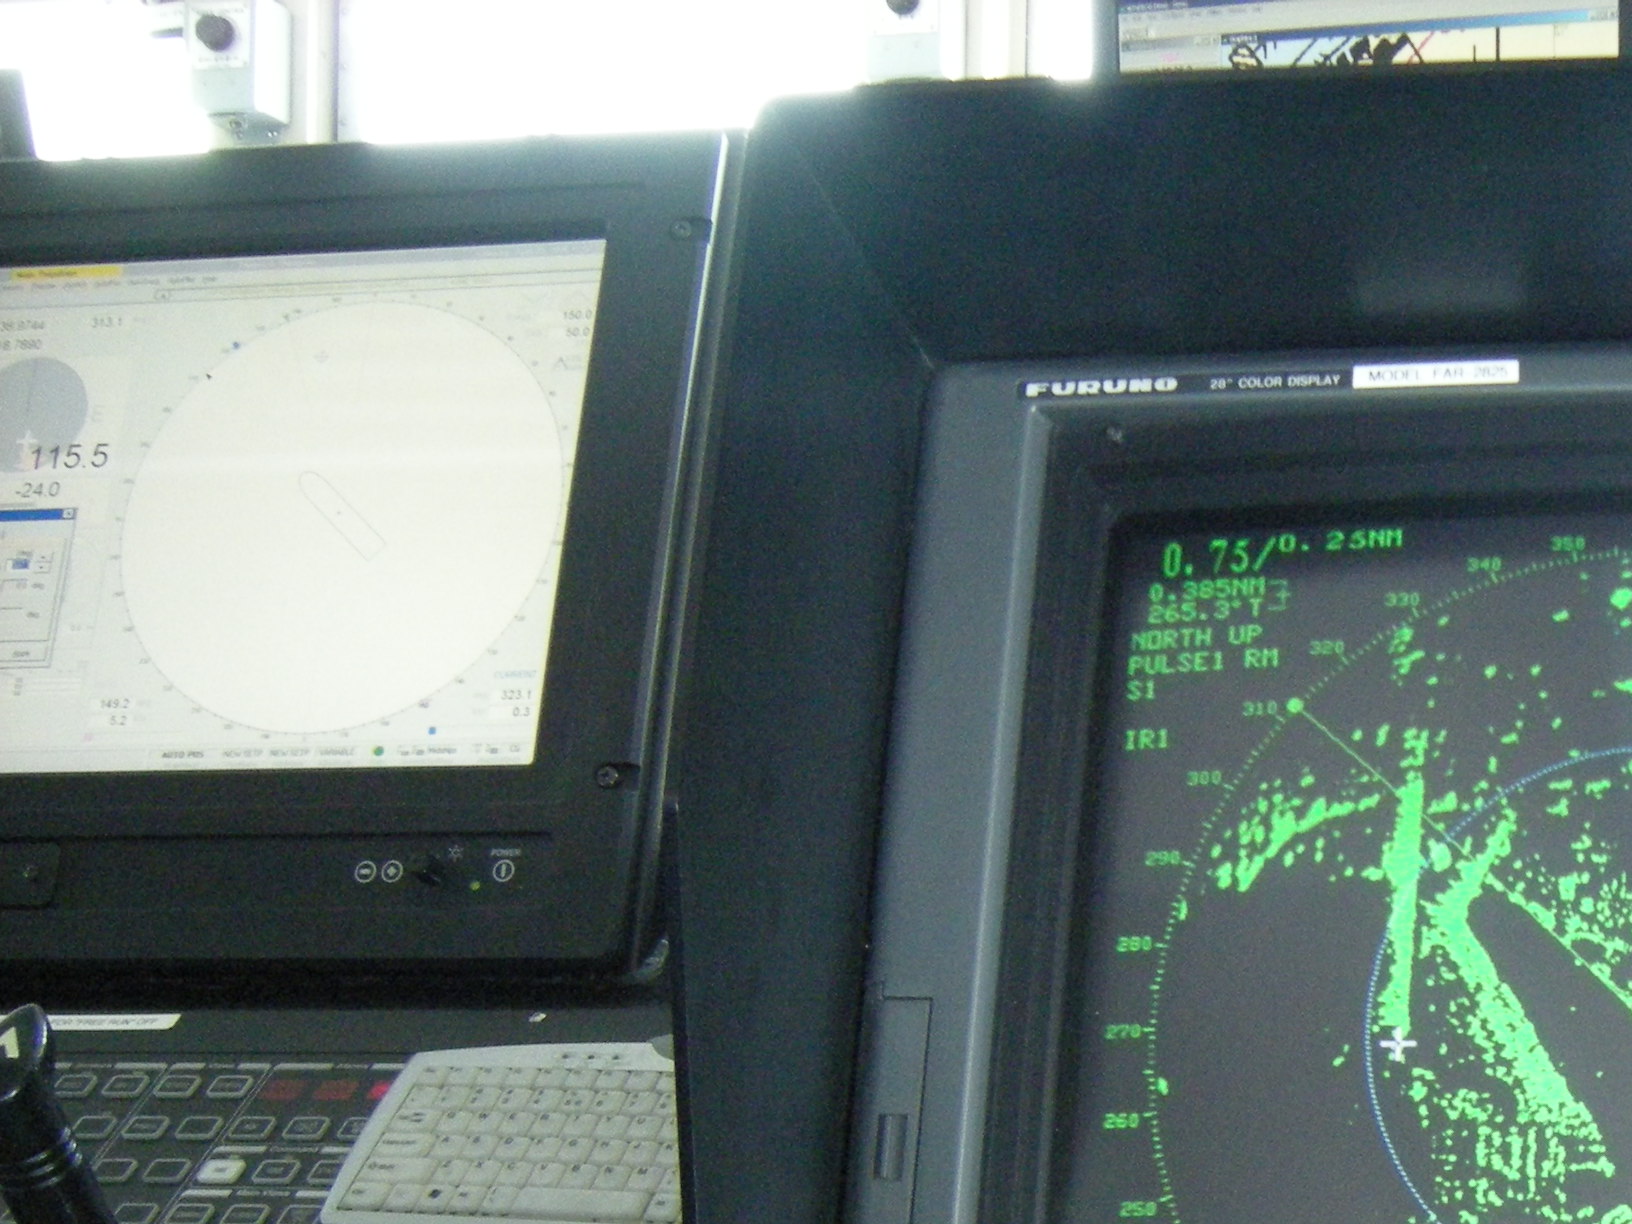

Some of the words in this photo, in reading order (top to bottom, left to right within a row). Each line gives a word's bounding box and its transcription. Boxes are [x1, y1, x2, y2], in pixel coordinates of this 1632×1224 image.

[1025, 376, 1178, 397] FURUNO
[1238, 376, 1282, 389] COLOR
[1287, 374, 1341, 388] DISPLAY
[1368, 369, 1421, 383] MODEL
[31, 442, 109, 471] 115.5
[1148, 576, 1266, 602] 0.385NM
[1130, 627, 1212, 650] NORTH
[1228, 624, 1263, 645] UP
[1127, 650, 1223, 676] PULSE1
[1243, 648, 1280, 668] RM
[1126, 679, 1155, 701] S1
[1125, 728, 1168, 751] IR1
